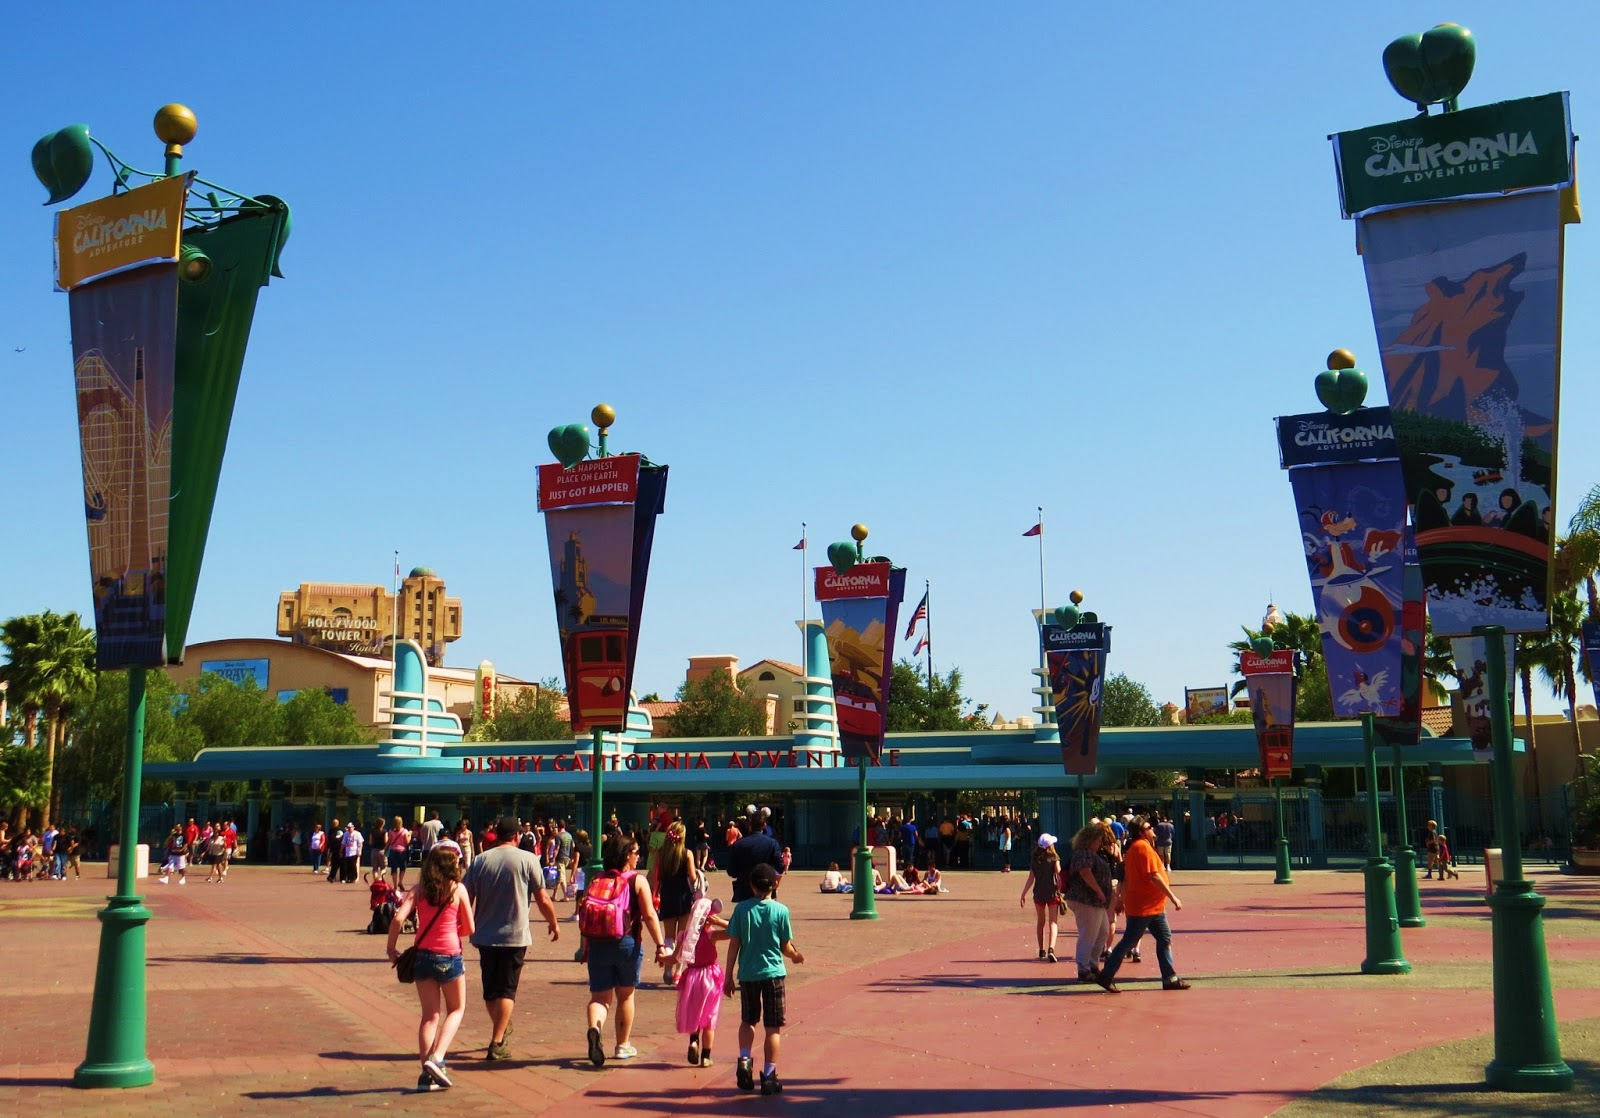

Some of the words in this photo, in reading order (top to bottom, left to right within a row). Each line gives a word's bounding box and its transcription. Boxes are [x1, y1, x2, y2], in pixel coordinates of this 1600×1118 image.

[1368, 134, 1424, 154] Disney
[1364, 130, 1538, 178] CALIFORNIA
[1402, 160, 1500, 184] ADVENTURE
[76, 213, 105, 230] Disney
[73, 207, 167, 254] CALIFORNIA
[89, 235, 143, 258] ADVENTURE
[1297, 420, 1330, 432] Disney
[1294, 424, 1394, 447] CALIFORNIA
[1316, 440, 1374, 451] ADVENTURE
[578, 461, 613, 472] HAPPIEST
[557, 474, 579, 484] PLACE
[580, 473, 592, 482] ON
[594, 471, 618, 480] EARTH
[549, 490, 567, 500] JUST
[569, 486, 587, 498] GOT
[589, 483, 629, 494] HAPPIER
[824, 575, 881, 588] CALIFORNIA
[307, 617, 377, 629] HOLLYWOOD
[321, 630, 361, 641] TOWER
[1049, 631, 1096, 641] CALIFORNIA
[348, 642, 379, 652] Hotel
[1247, 658, 1288, 667] CALIFORNIA
[462, 755, 544, 773] DISNEY
[553, 752, 711, 771] CALIFORNIA
